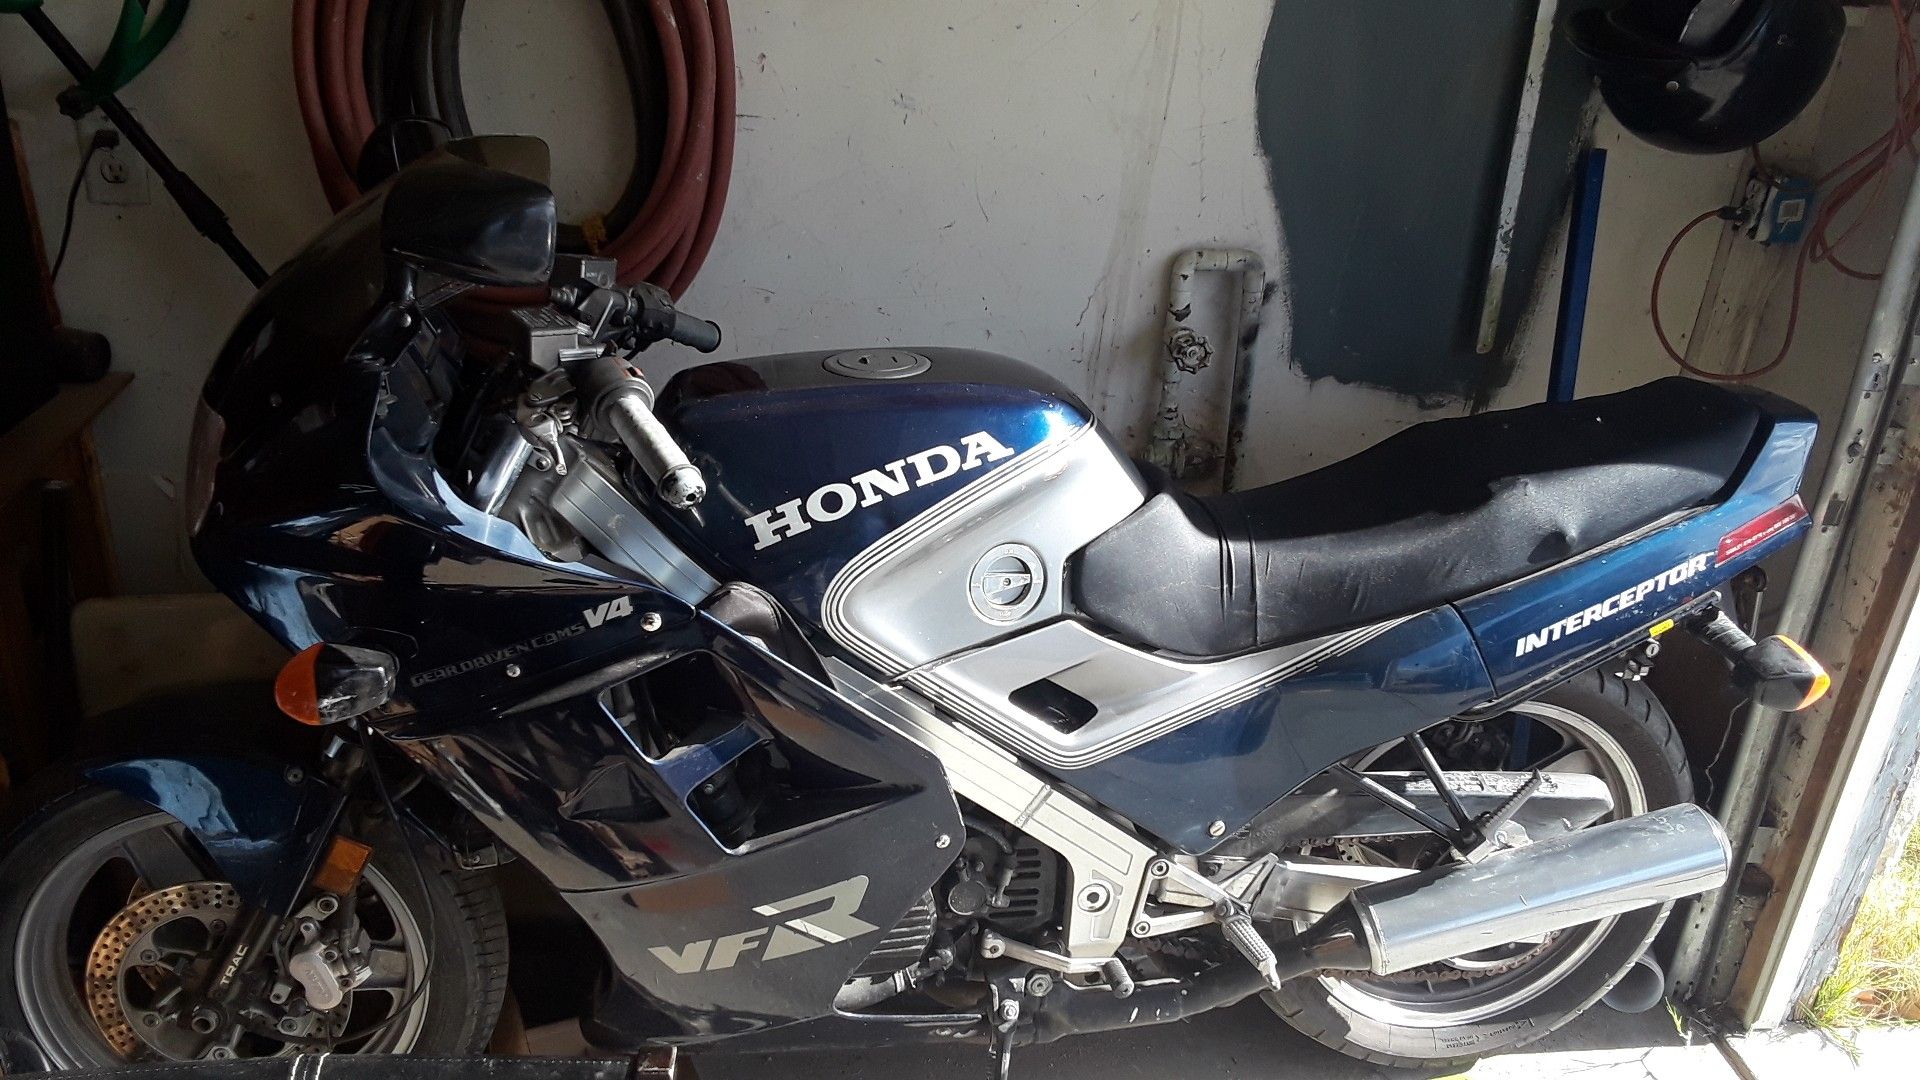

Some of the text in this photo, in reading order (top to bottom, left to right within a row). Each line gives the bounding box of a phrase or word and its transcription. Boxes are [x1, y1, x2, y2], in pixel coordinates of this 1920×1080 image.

[744, 430, 1015, 551] HONDA
[410, 595, 634, 688] GEAR DRIVEN CAMS V4
[1515, 553, 1708, 657] INTERCEPTOR
[219, 944, 249, 986] TRAC
[647, 874, 881, 975] VFR
